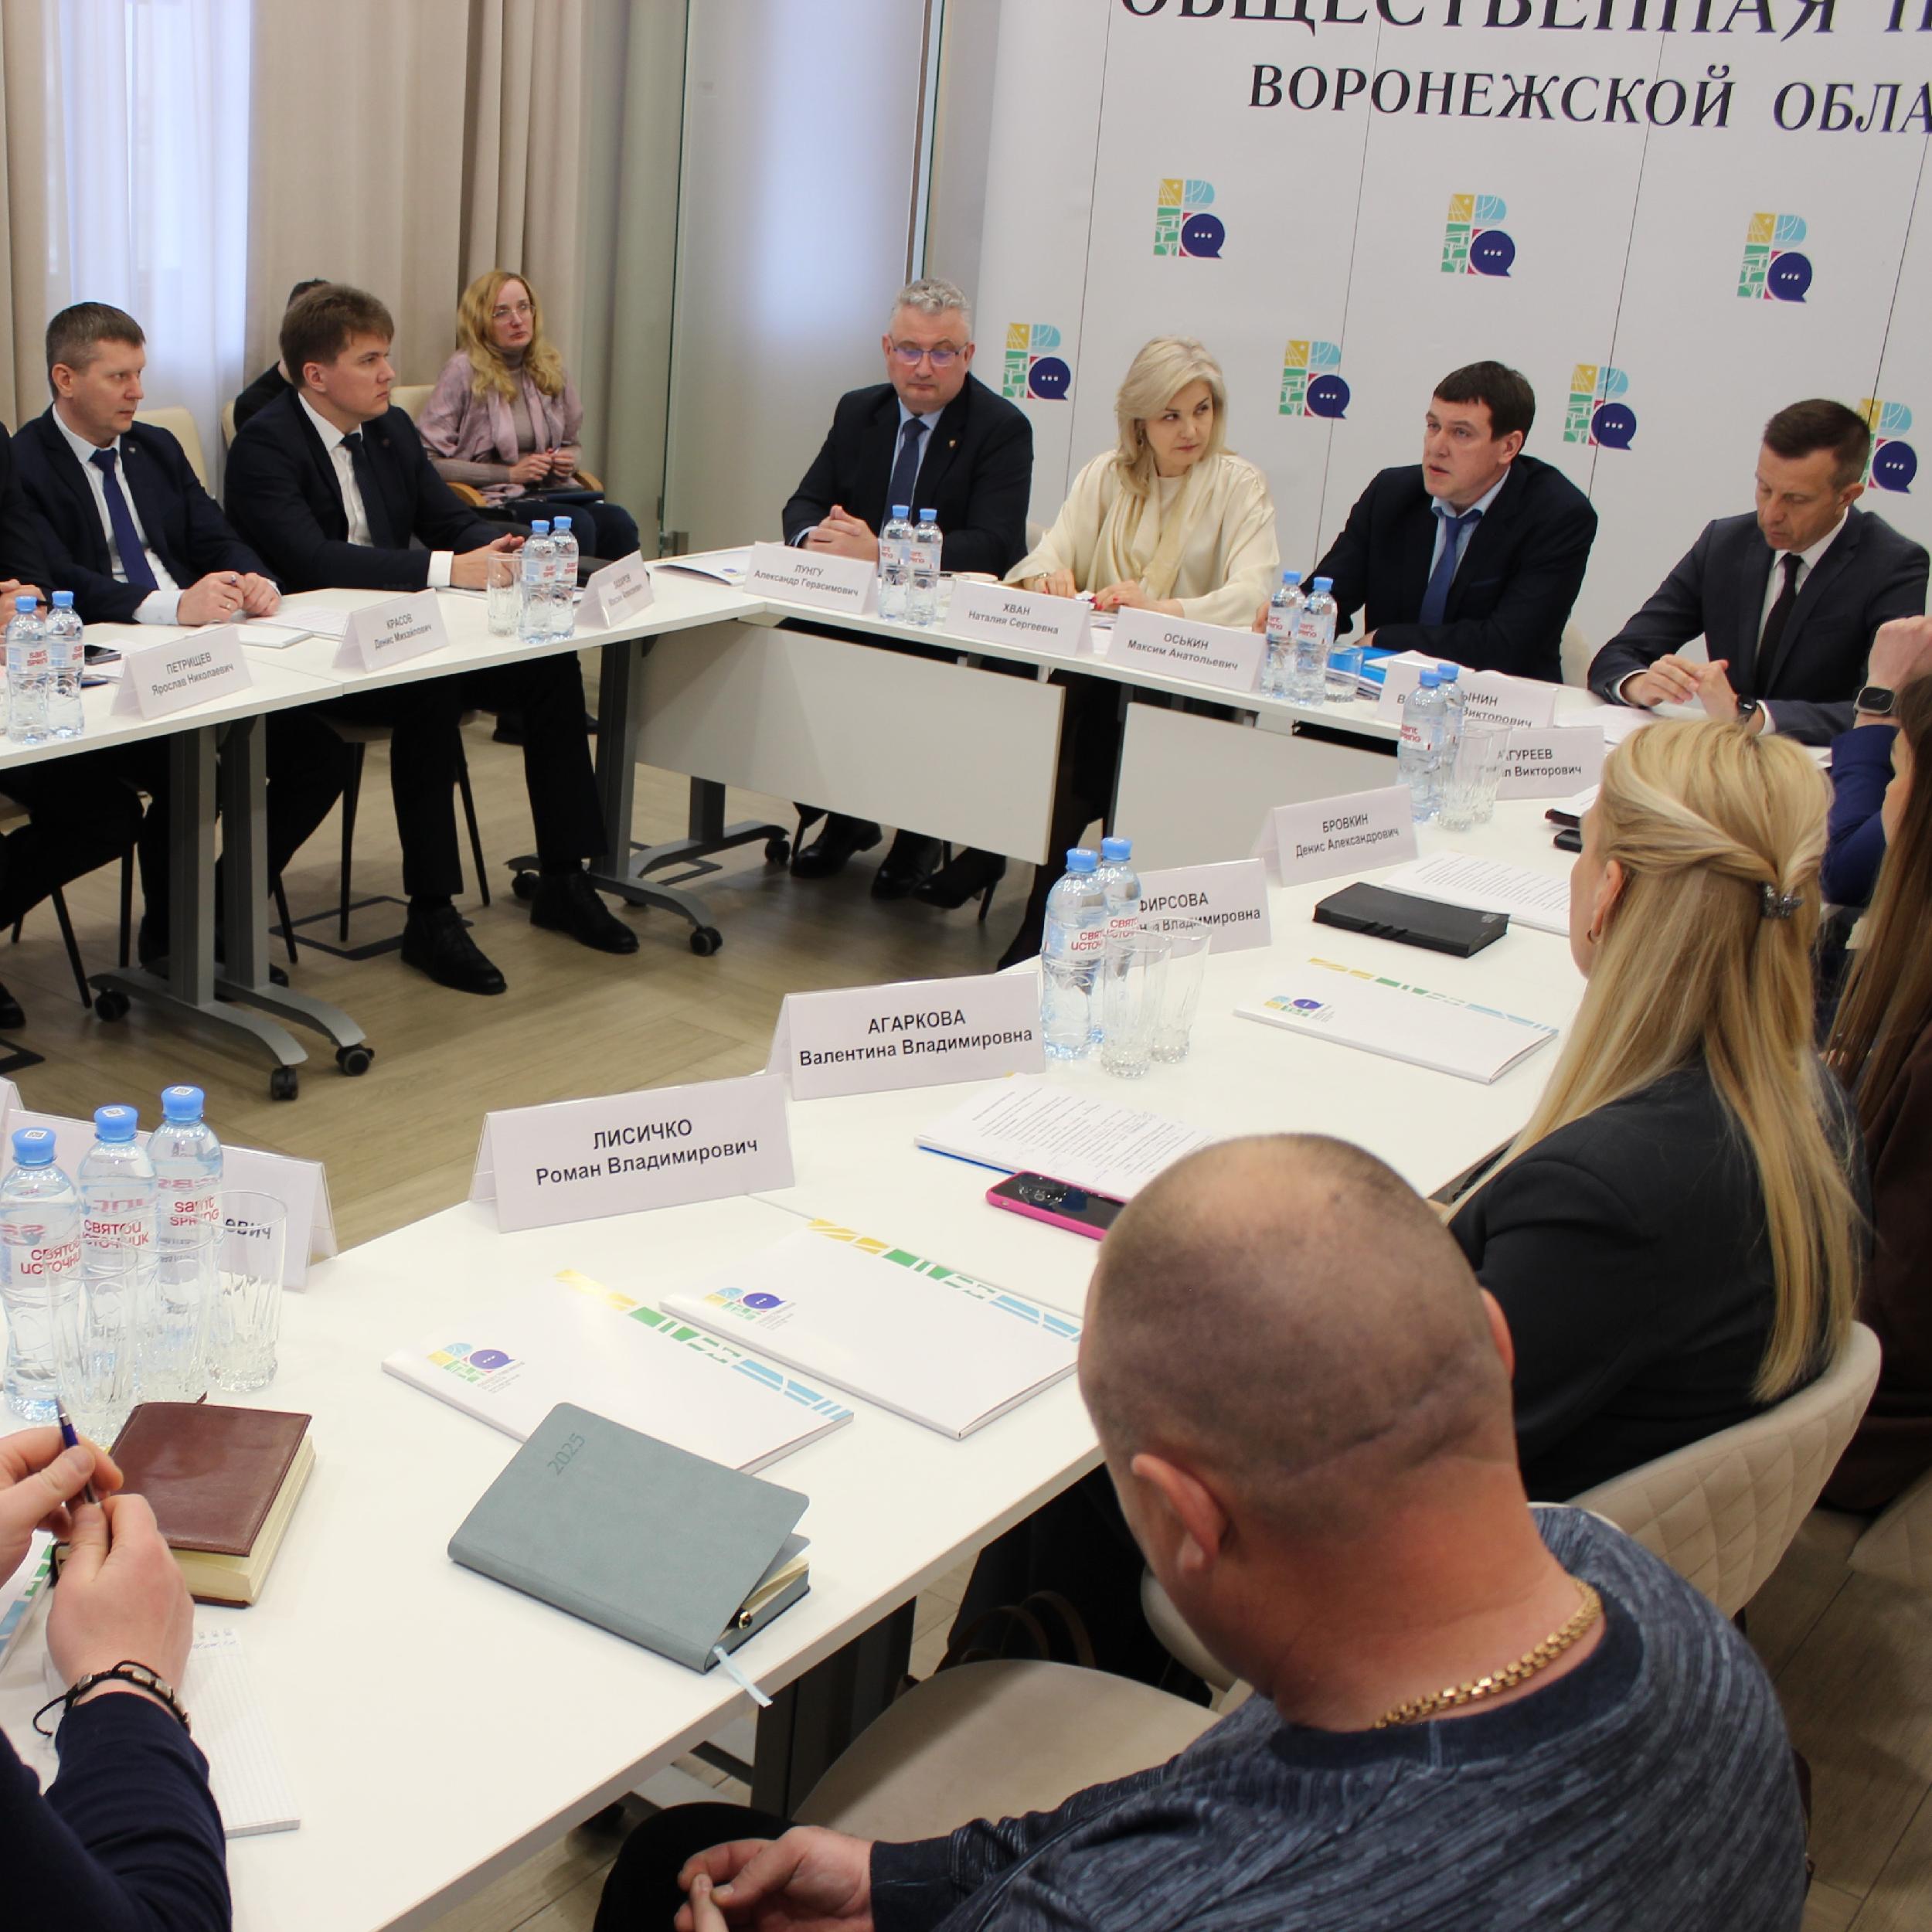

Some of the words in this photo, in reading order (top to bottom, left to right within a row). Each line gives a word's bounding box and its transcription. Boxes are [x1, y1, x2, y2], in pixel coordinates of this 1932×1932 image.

[1247, 63, 1736, 128] ВОРОНЕЖСКОЙ
[1773, 80, 1932, 134] ОБЛА
[754, 570, 799, 586] Александр
[801, 578, 859, 596] Герасимович
[794, 564, 824, 577] ЛУНГУ
[386, 613, 413, 630] КРАСОВ
[1003, 603, 1031, 615] ХВАН
[968, 611, 1007, 625] Наталия
[1009, 617, 1059, 634] Сергеевна
[1128, 639, 1166, 655] Максим
[1168, 648, 1238, 670] Анатольевич
[1164, 633, 1209, 650] ОСЬКИН
[166, 652, 212, 674] ПЕТРИЩЕВ
[151, 678, 187, 696] Ярослав
[187, 663, 234, 684] Николаевич
[1461, 691, 1498, 706] ЫНИН
[1514, 766, 1582, 777] Викторович
[1322, 813, 1369, 833] БРОВКИН
[1296, 843, 1325, 859] Денис
[1328, 828, 1400, 851] Александрович
[868, 1009, 966, 1035] АГАРКОВА
[800, 1044, 896, 1066] Валентина
[902, 1029, 1032, 1056] Владимировна
[594, 1119, 692, 1150] ЛИСИЧКО
[536, 1163, 601, 1185] Роман
[608, 1140, 757, 1174] Владимирович
[547, 1433, 585, 1475] 2025
